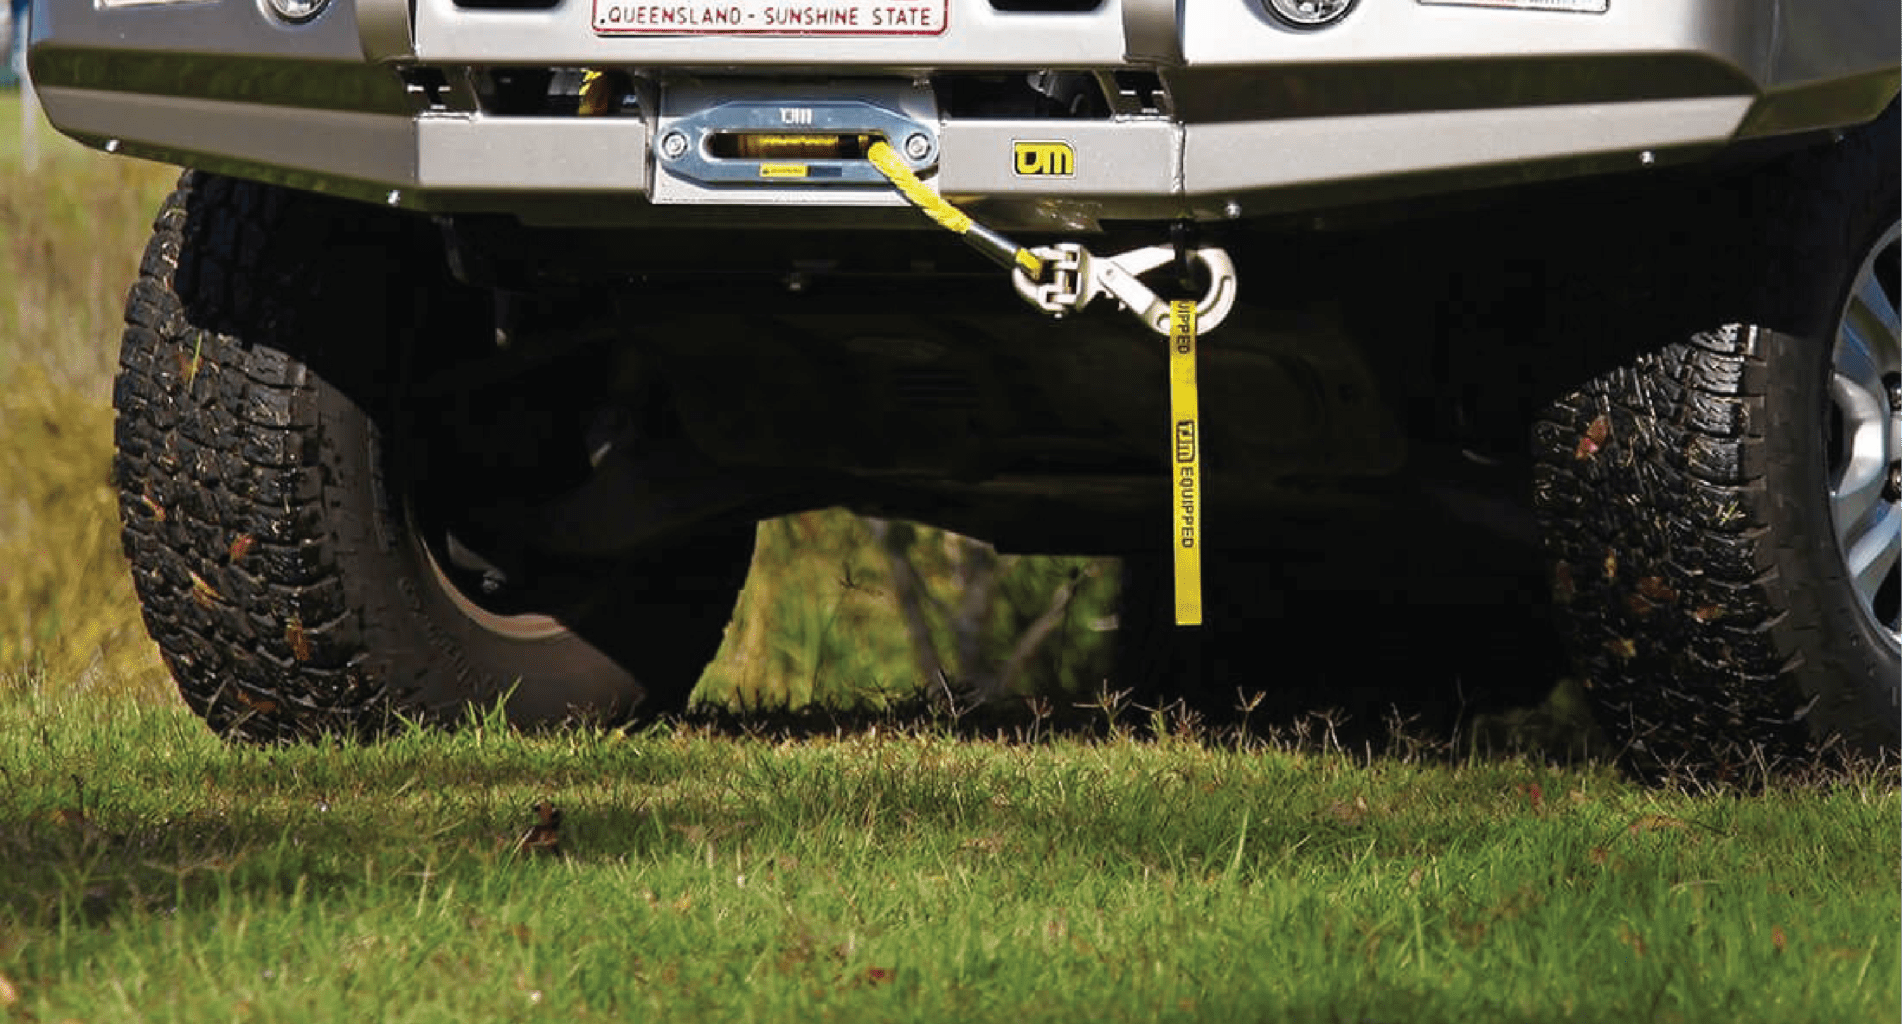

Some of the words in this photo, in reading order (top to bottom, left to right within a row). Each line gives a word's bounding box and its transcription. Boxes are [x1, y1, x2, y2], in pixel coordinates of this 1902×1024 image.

[608, 6, 741, 25] QUEENSLAND
[764, 6, 858, 26] SUNSHINE
[872, 6, 931, 26] STATE
[1179, 466, 1194, 549] EQUIPPED
